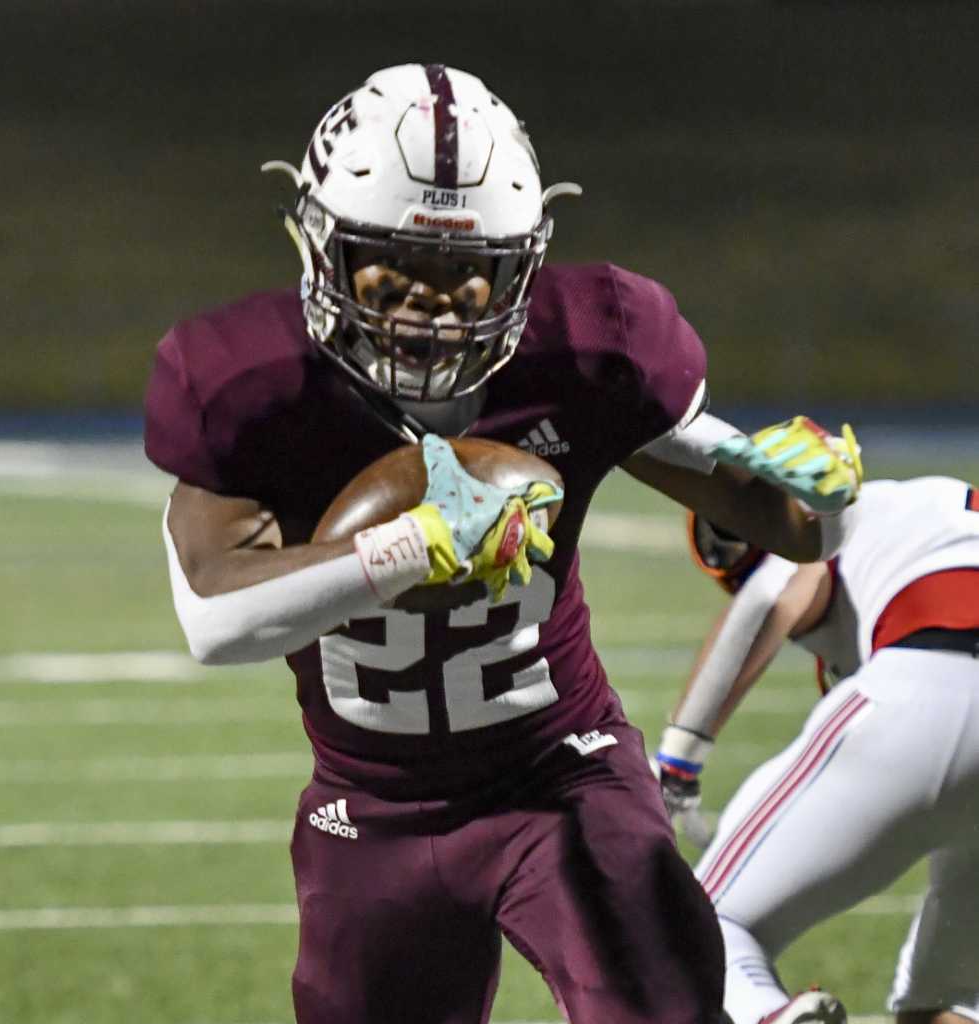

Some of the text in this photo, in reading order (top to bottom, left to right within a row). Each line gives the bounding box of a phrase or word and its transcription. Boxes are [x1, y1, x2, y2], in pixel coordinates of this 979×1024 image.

[421, 189, 458, 208] PLUS
[319, 564, 559, 736] 22
[309, 812, 358, 839] adidas
